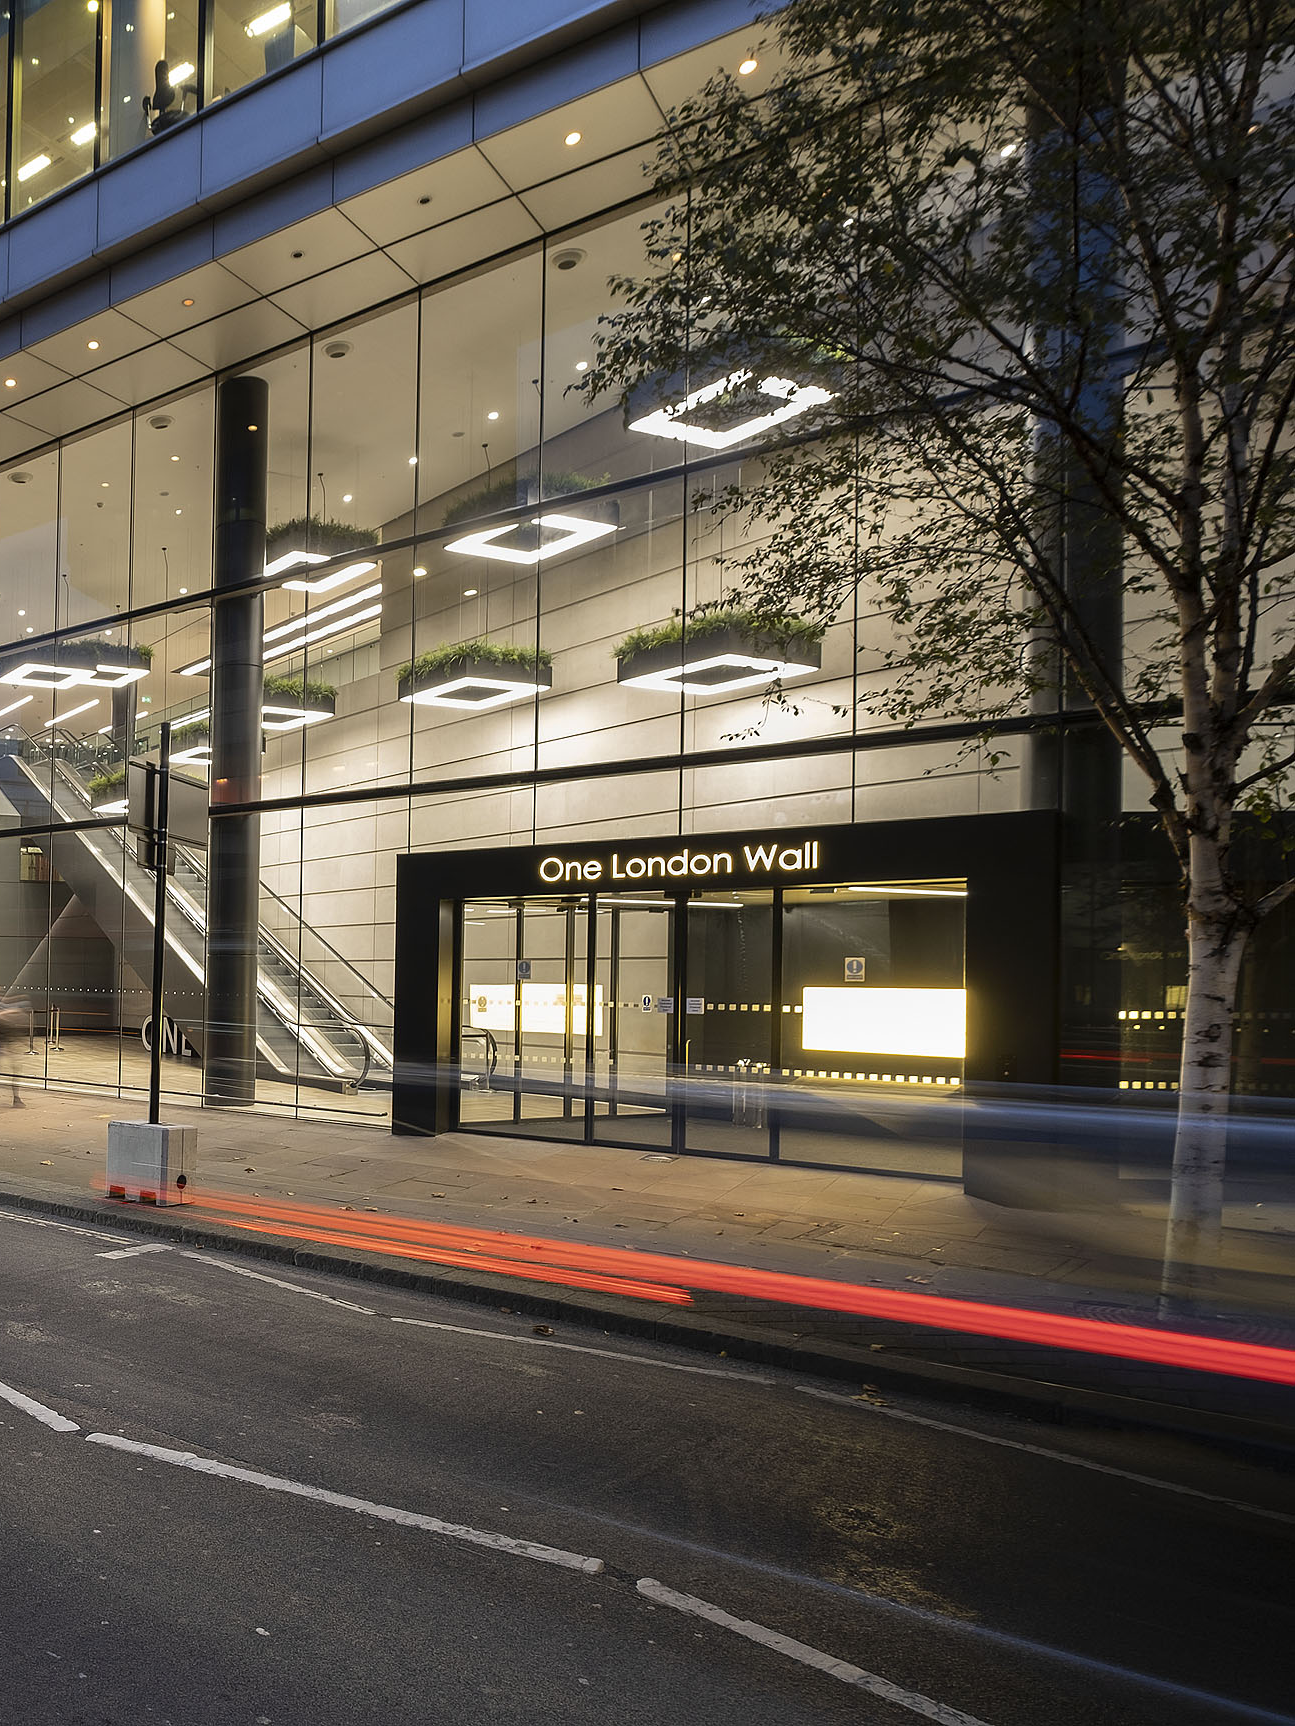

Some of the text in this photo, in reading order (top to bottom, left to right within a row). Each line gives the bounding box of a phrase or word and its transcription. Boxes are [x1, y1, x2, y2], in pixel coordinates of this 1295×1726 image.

[539, 841, 819, 883] One London Wall
